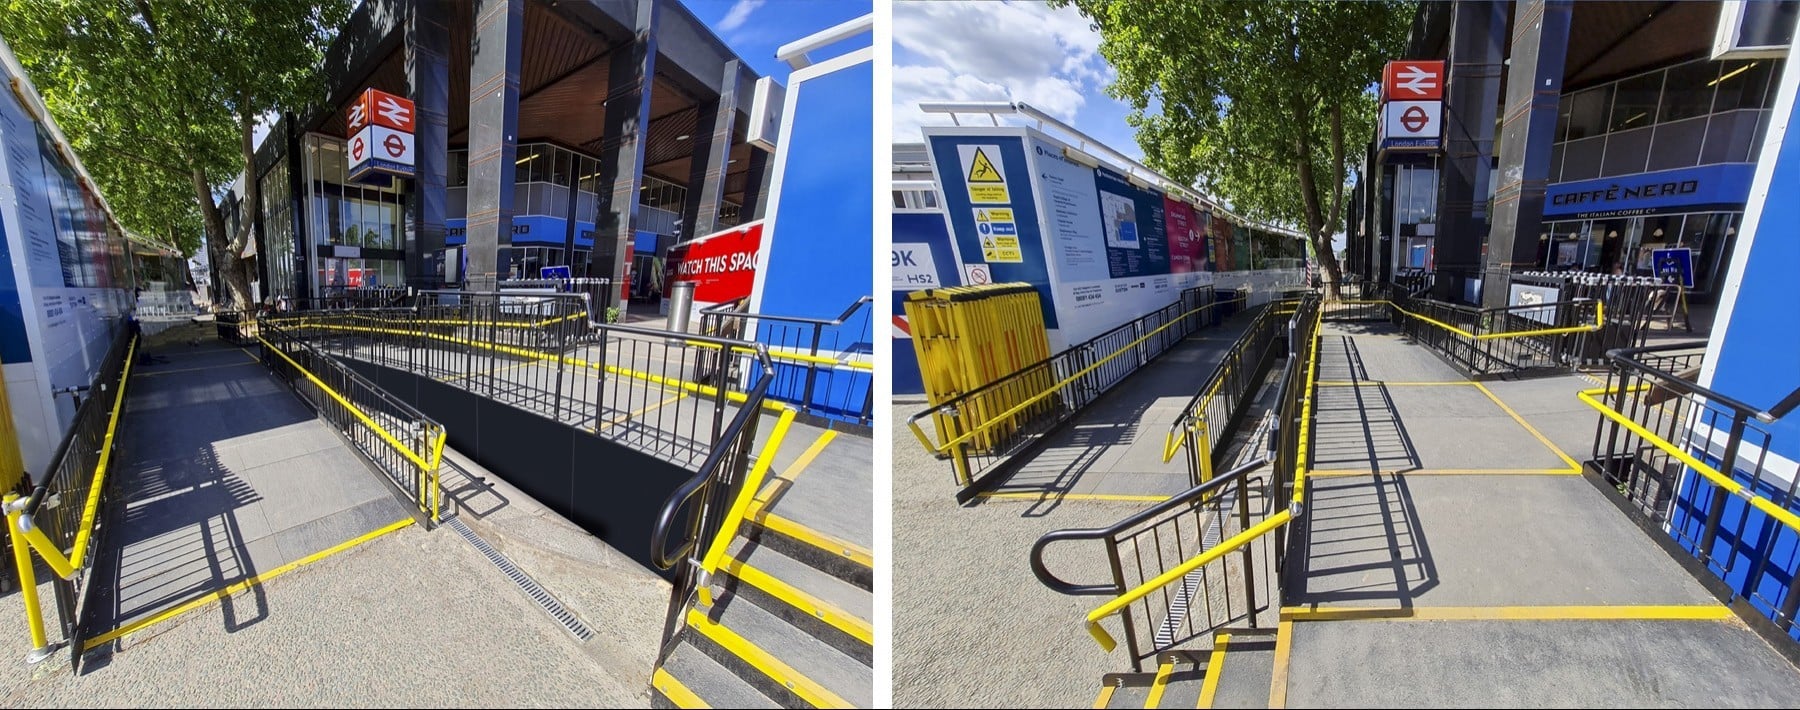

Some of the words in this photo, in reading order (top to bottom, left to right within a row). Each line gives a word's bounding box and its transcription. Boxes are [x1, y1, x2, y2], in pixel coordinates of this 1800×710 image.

[1553, 184, 1619, 206] CAFFÈ
[1624, 180, 1699, 199] NERO
[1617, 209, 1643, 217] COFFEE
[677, 258, 704, 275] WATCH
[704, 254, 728, 273] THIS
[907, 274, 933, 284] HS2
